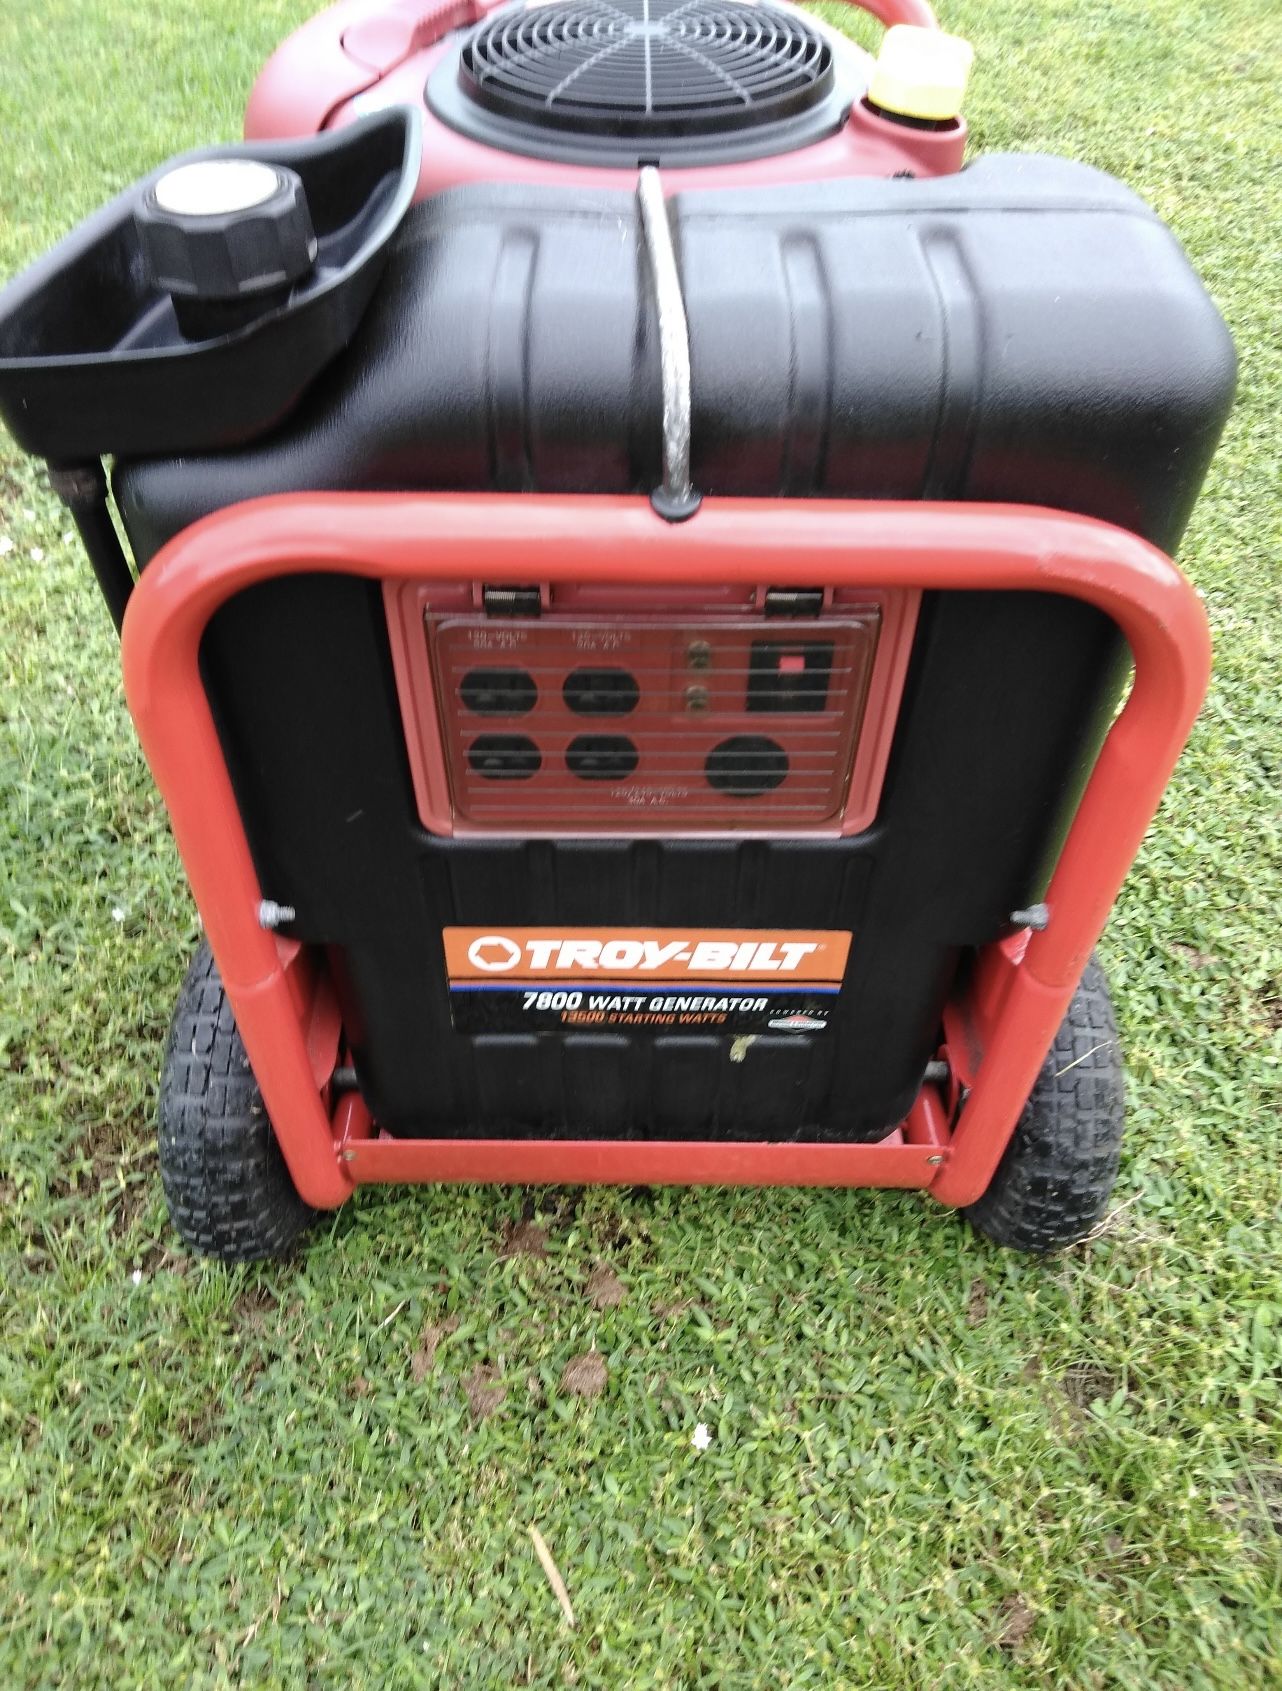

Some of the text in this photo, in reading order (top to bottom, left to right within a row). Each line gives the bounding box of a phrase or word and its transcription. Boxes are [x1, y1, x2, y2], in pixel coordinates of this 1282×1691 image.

[525, 939, 818, 970] TROY-BILT
[522, 992, 768, 1012] 7800 WATT GENERATOR
[608, 1013, 675, 1024] STARTING
[679, 1013, 728, 1024] WATTS
